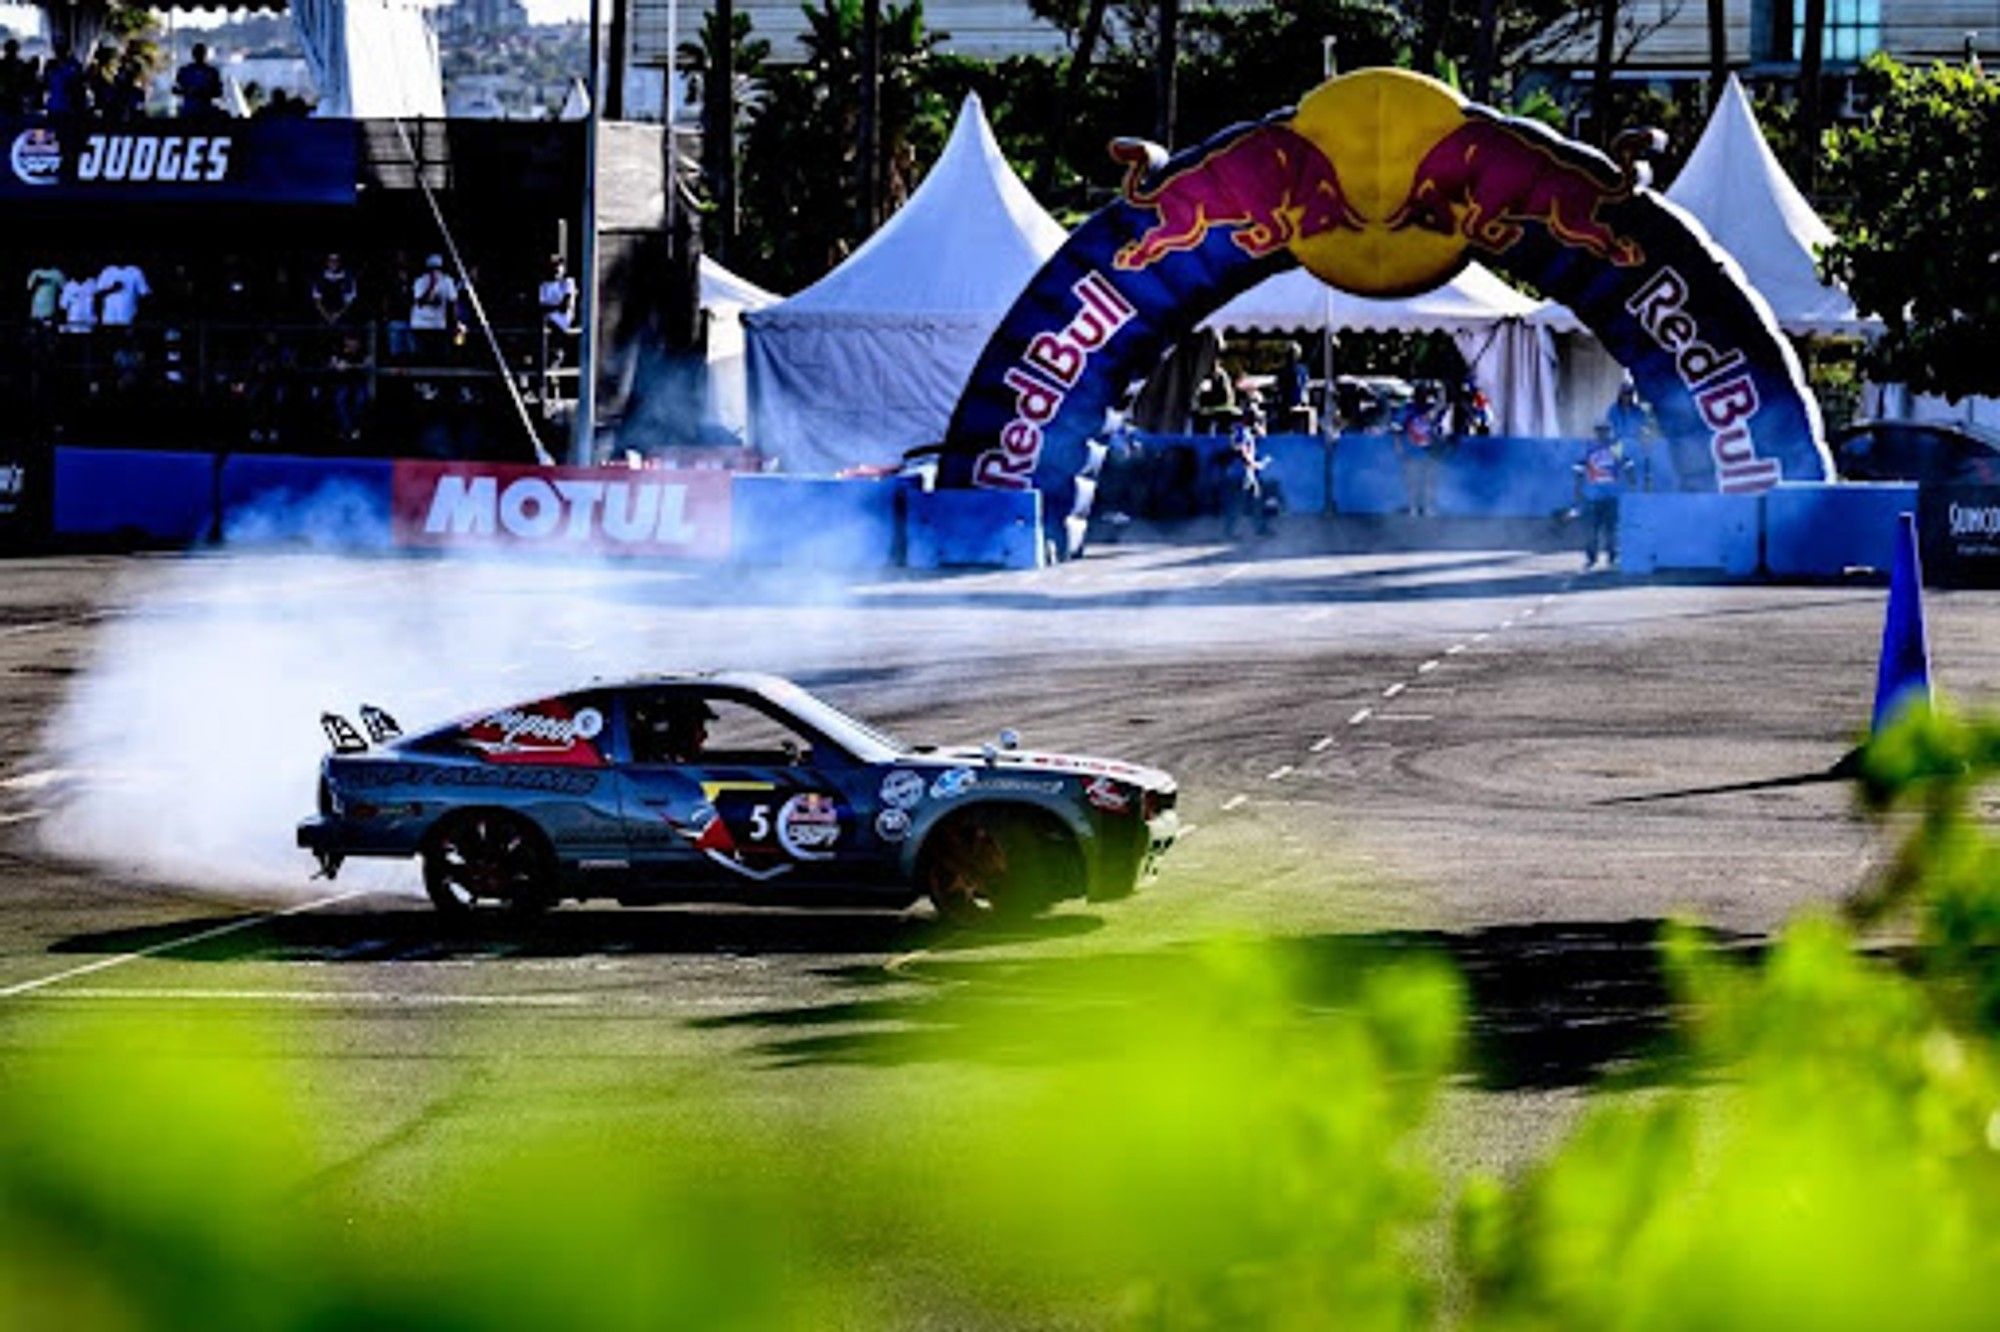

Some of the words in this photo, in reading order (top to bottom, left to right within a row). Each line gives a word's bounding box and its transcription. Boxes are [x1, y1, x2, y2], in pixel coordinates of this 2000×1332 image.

[77, 136, 231, 181] JUDGES
[425, 474, 698, 544] MOTUL
[750, 804, 769, 839] 5
